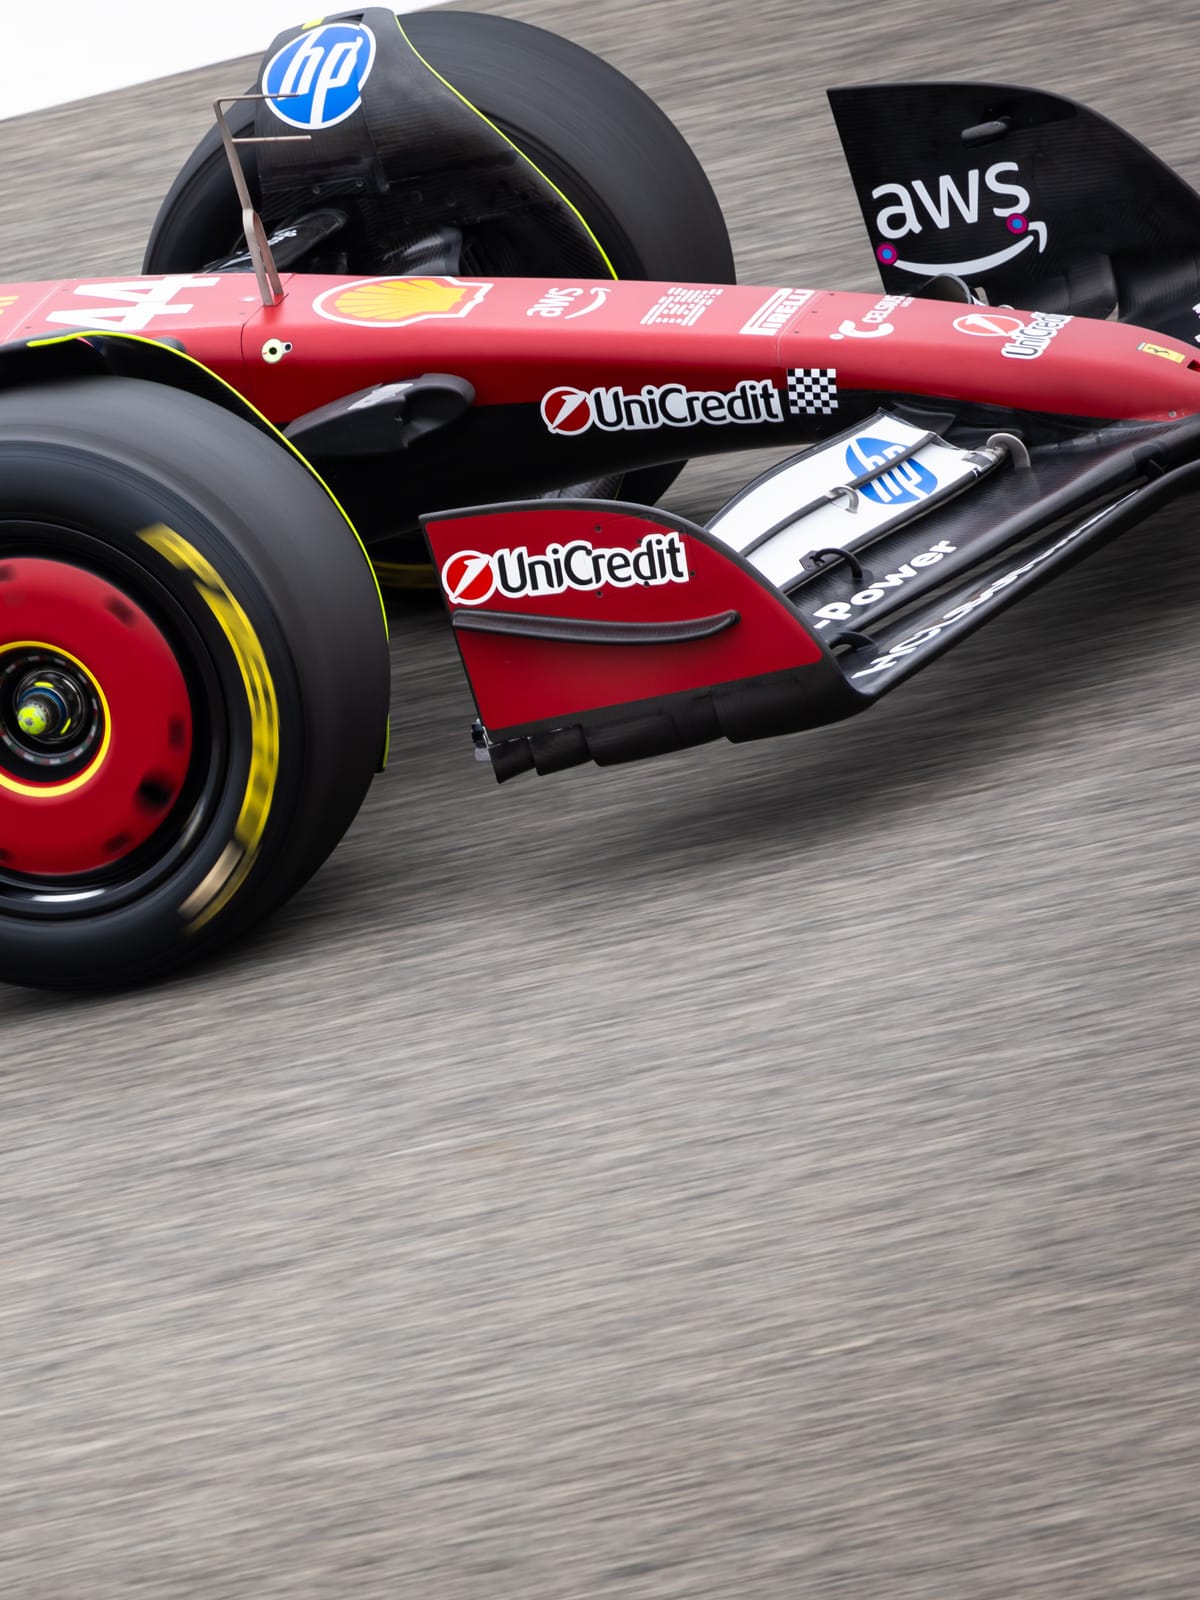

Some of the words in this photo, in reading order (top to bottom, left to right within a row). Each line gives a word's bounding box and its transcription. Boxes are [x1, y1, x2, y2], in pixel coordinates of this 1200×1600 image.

[269, 30, 368, 128] hp
[872, 161, 1030, 239] aws
[46, 275, 220, 331] 44
[526, 287, 584, 318] aws
[639, 287, 724, 327] IBM
[738, 287, 816, 336] PIRELLI
[592, 381, 782, 430] UniCredit
[498, 534, 688, 596] UniCredit
